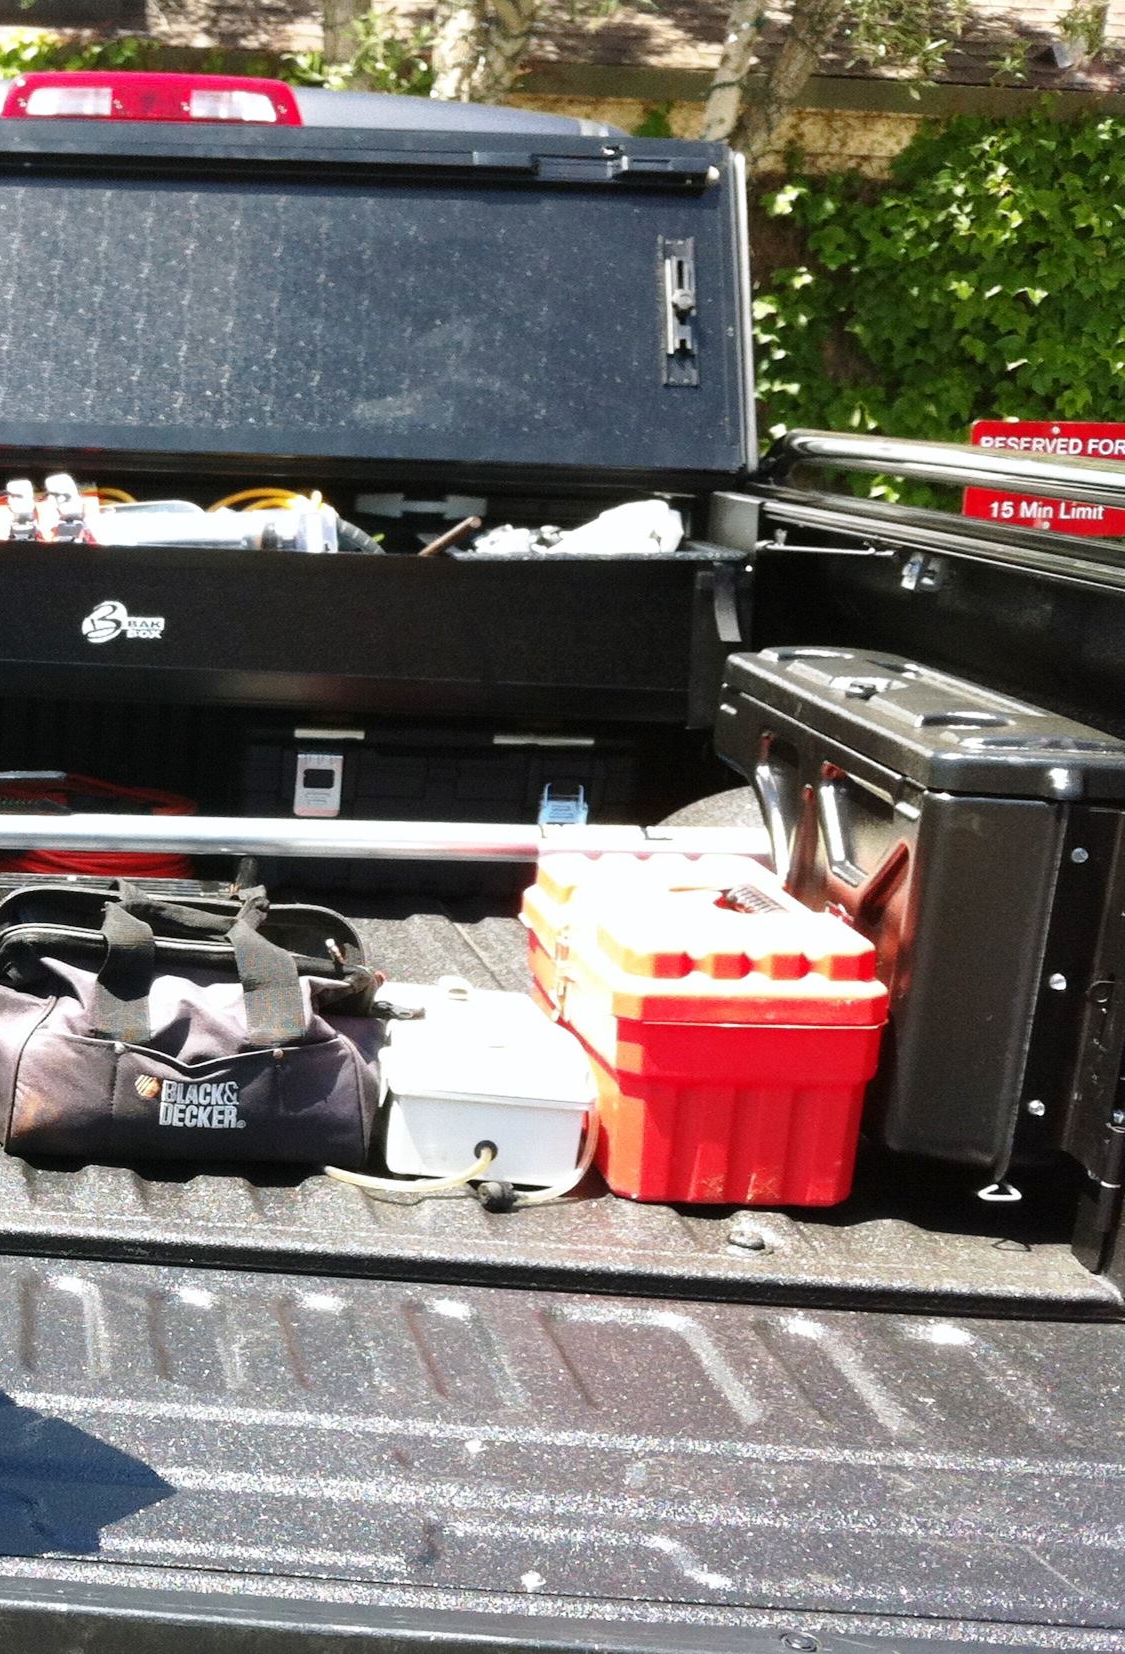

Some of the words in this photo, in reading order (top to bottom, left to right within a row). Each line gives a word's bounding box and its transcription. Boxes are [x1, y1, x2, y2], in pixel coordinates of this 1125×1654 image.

[980, 436, 1083, 455] RESERVED
[1088, 439, 1125, 455] FOR
[990, 501, 1014, 518] 15
[1020, 501, 1053, 518] Min
[1060, 502, 1105, 520] Limit
